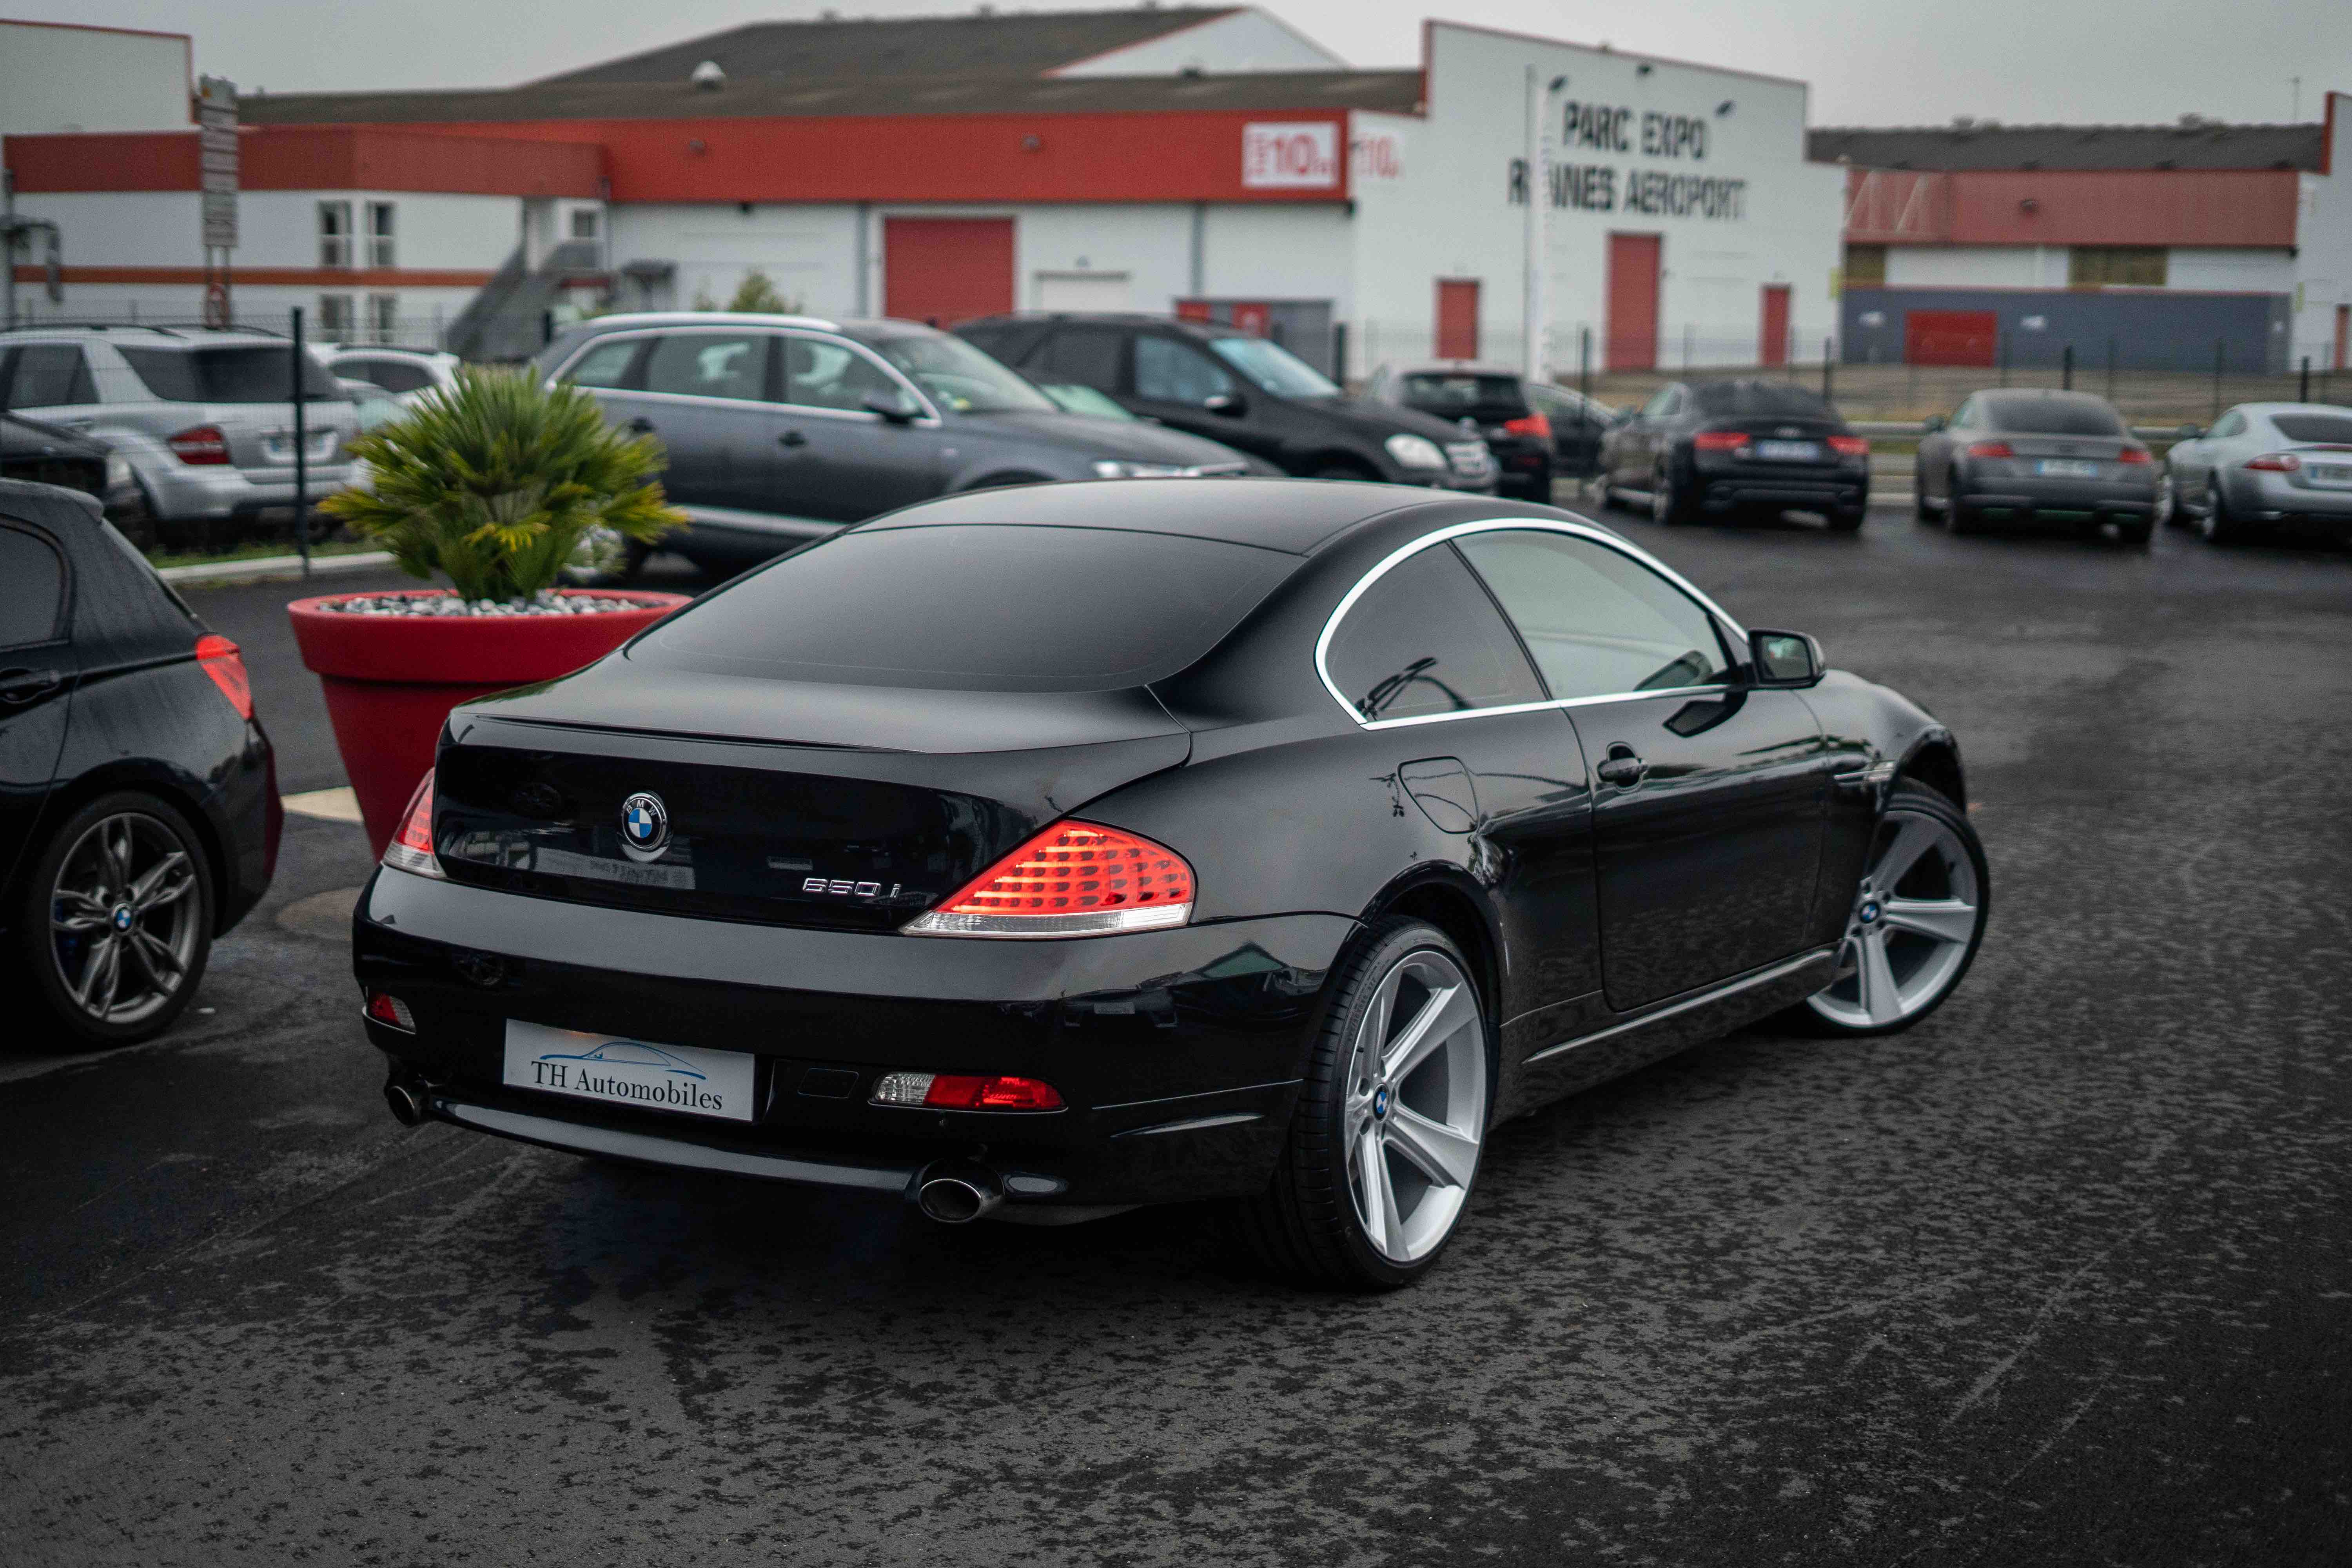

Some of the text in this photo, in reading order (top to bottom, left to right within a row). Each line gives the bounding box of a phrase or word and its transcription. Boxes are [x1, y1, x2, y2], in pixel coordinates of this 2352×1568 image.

[1563, 101, 1706, 160] PARC EXPO
[1508, 157, 1747, 220] RNNES AEROPORT
[626, 800, 657, 817] BMW
[531, 1060, 723, 1111] TH Automobiles
